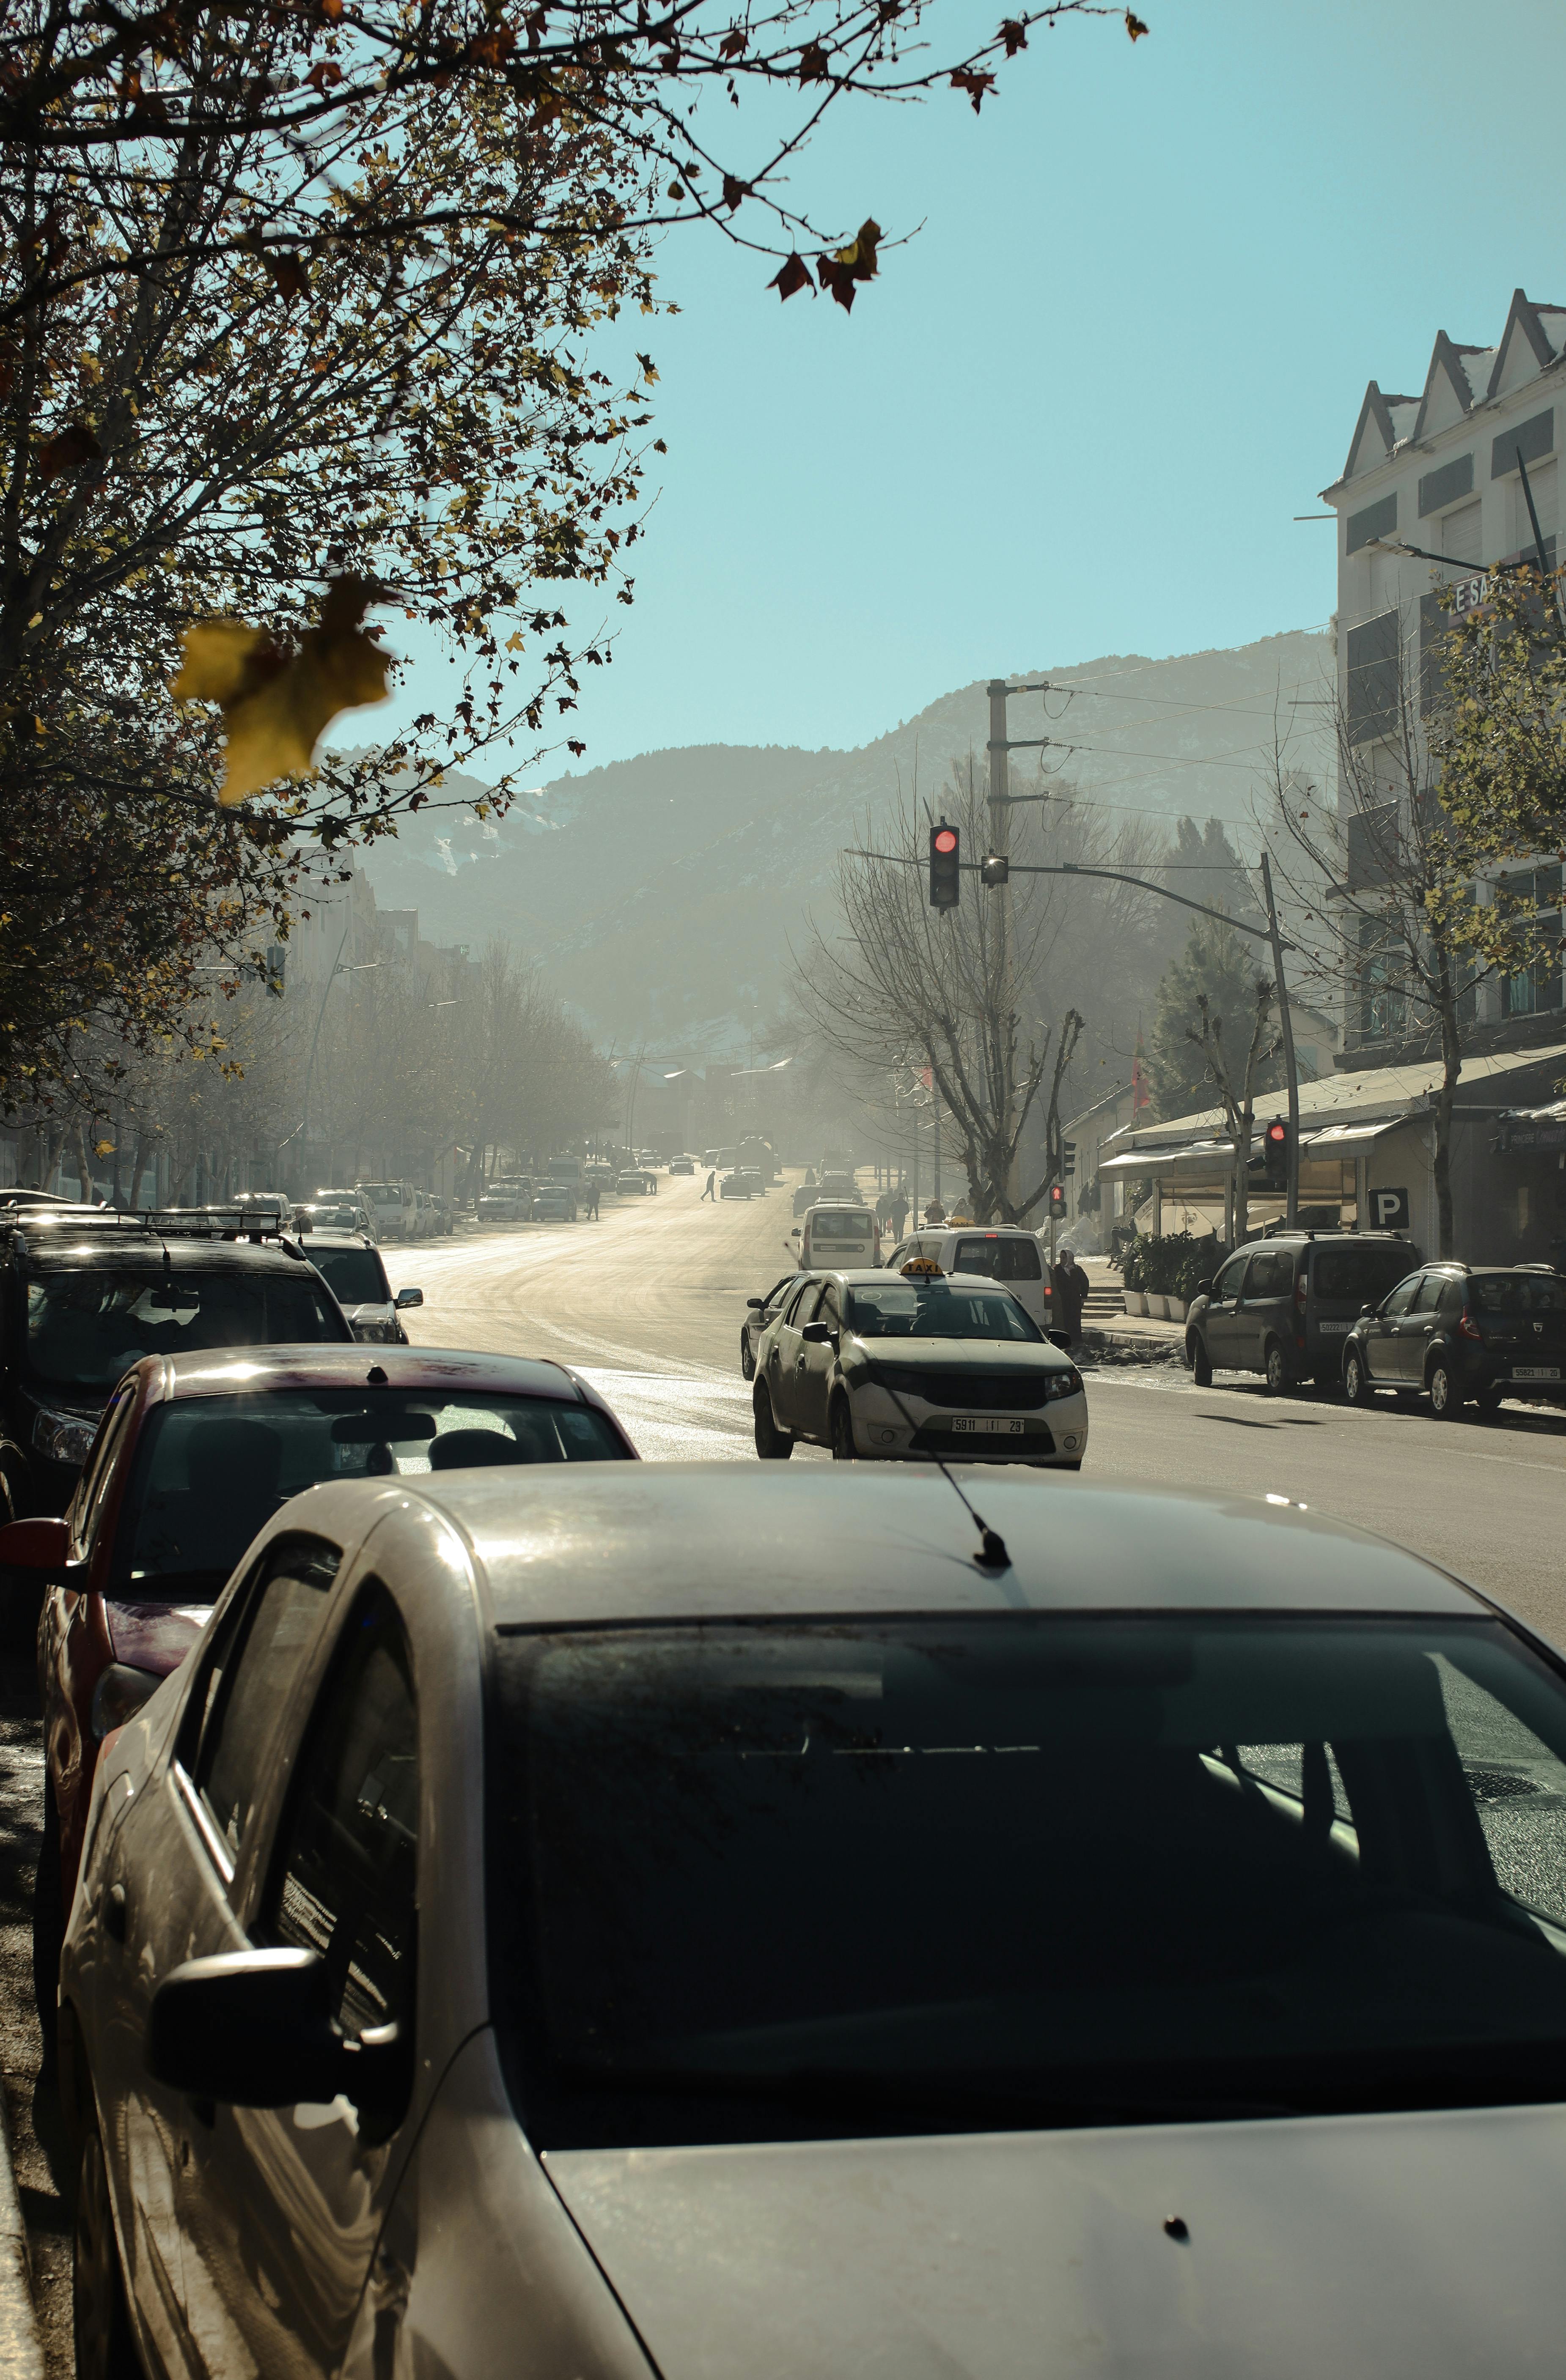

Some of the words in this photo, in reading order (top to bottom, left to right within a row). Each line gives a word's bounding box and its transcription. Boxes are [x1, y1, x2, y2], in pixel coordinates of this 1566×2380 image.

[1378, 1194, 1401, 1224] P
[907, 1264, 939, 1272] TAXI
[956, 1419, 975, 1431] 5911
[1010, 1421, 1021, 1432] 23
